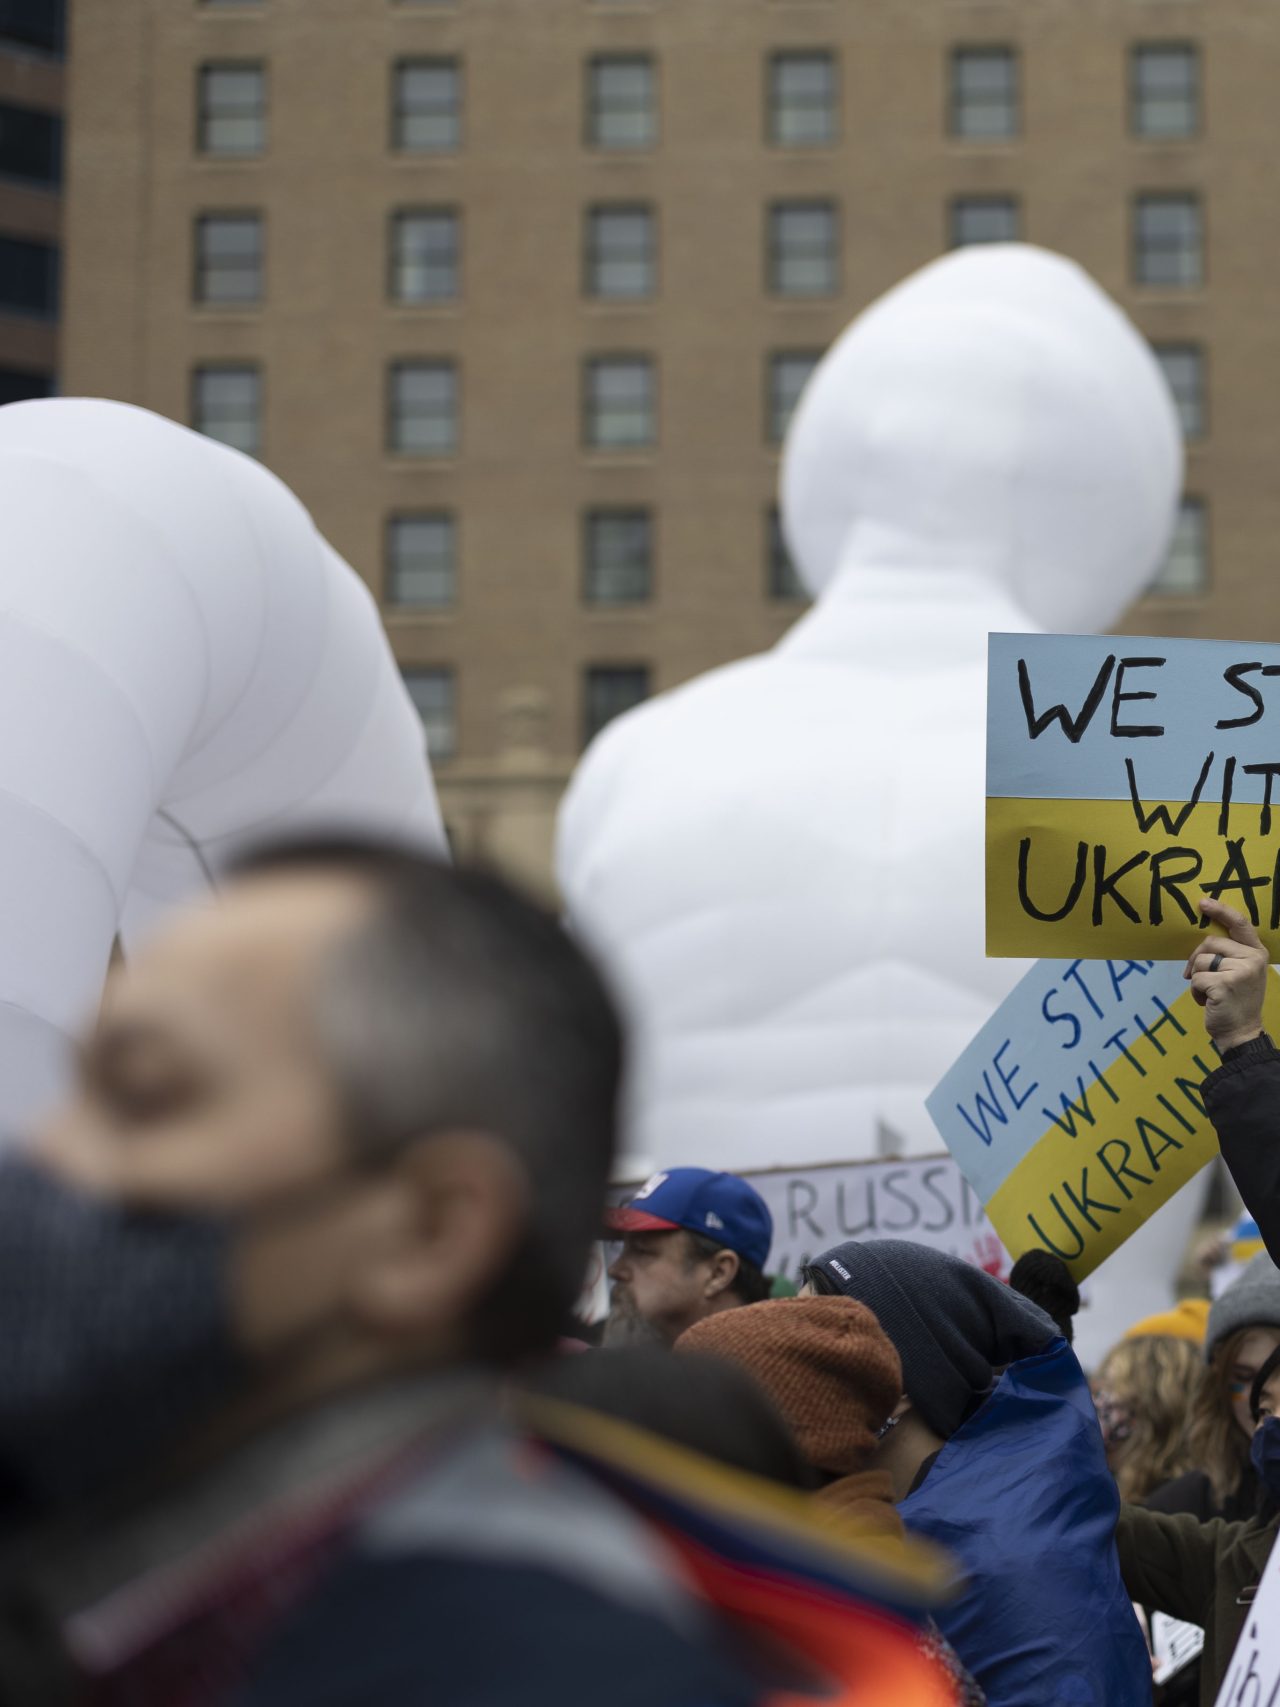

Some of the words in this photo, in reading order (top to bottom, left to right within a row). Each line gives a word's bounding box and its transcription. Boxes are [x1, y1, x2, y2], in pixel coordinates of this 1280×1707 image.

[1018, 654, 1166, 743] WE
[956, 1038, 1039, 1147] WE
[1042, 959, 1155, 1049] STA
[1041, 996, 1188, 1139] WITH
[786, 1165, 986, 1240] RUSSI
[1027, 1039, 1222, 1260] UKRAIN
